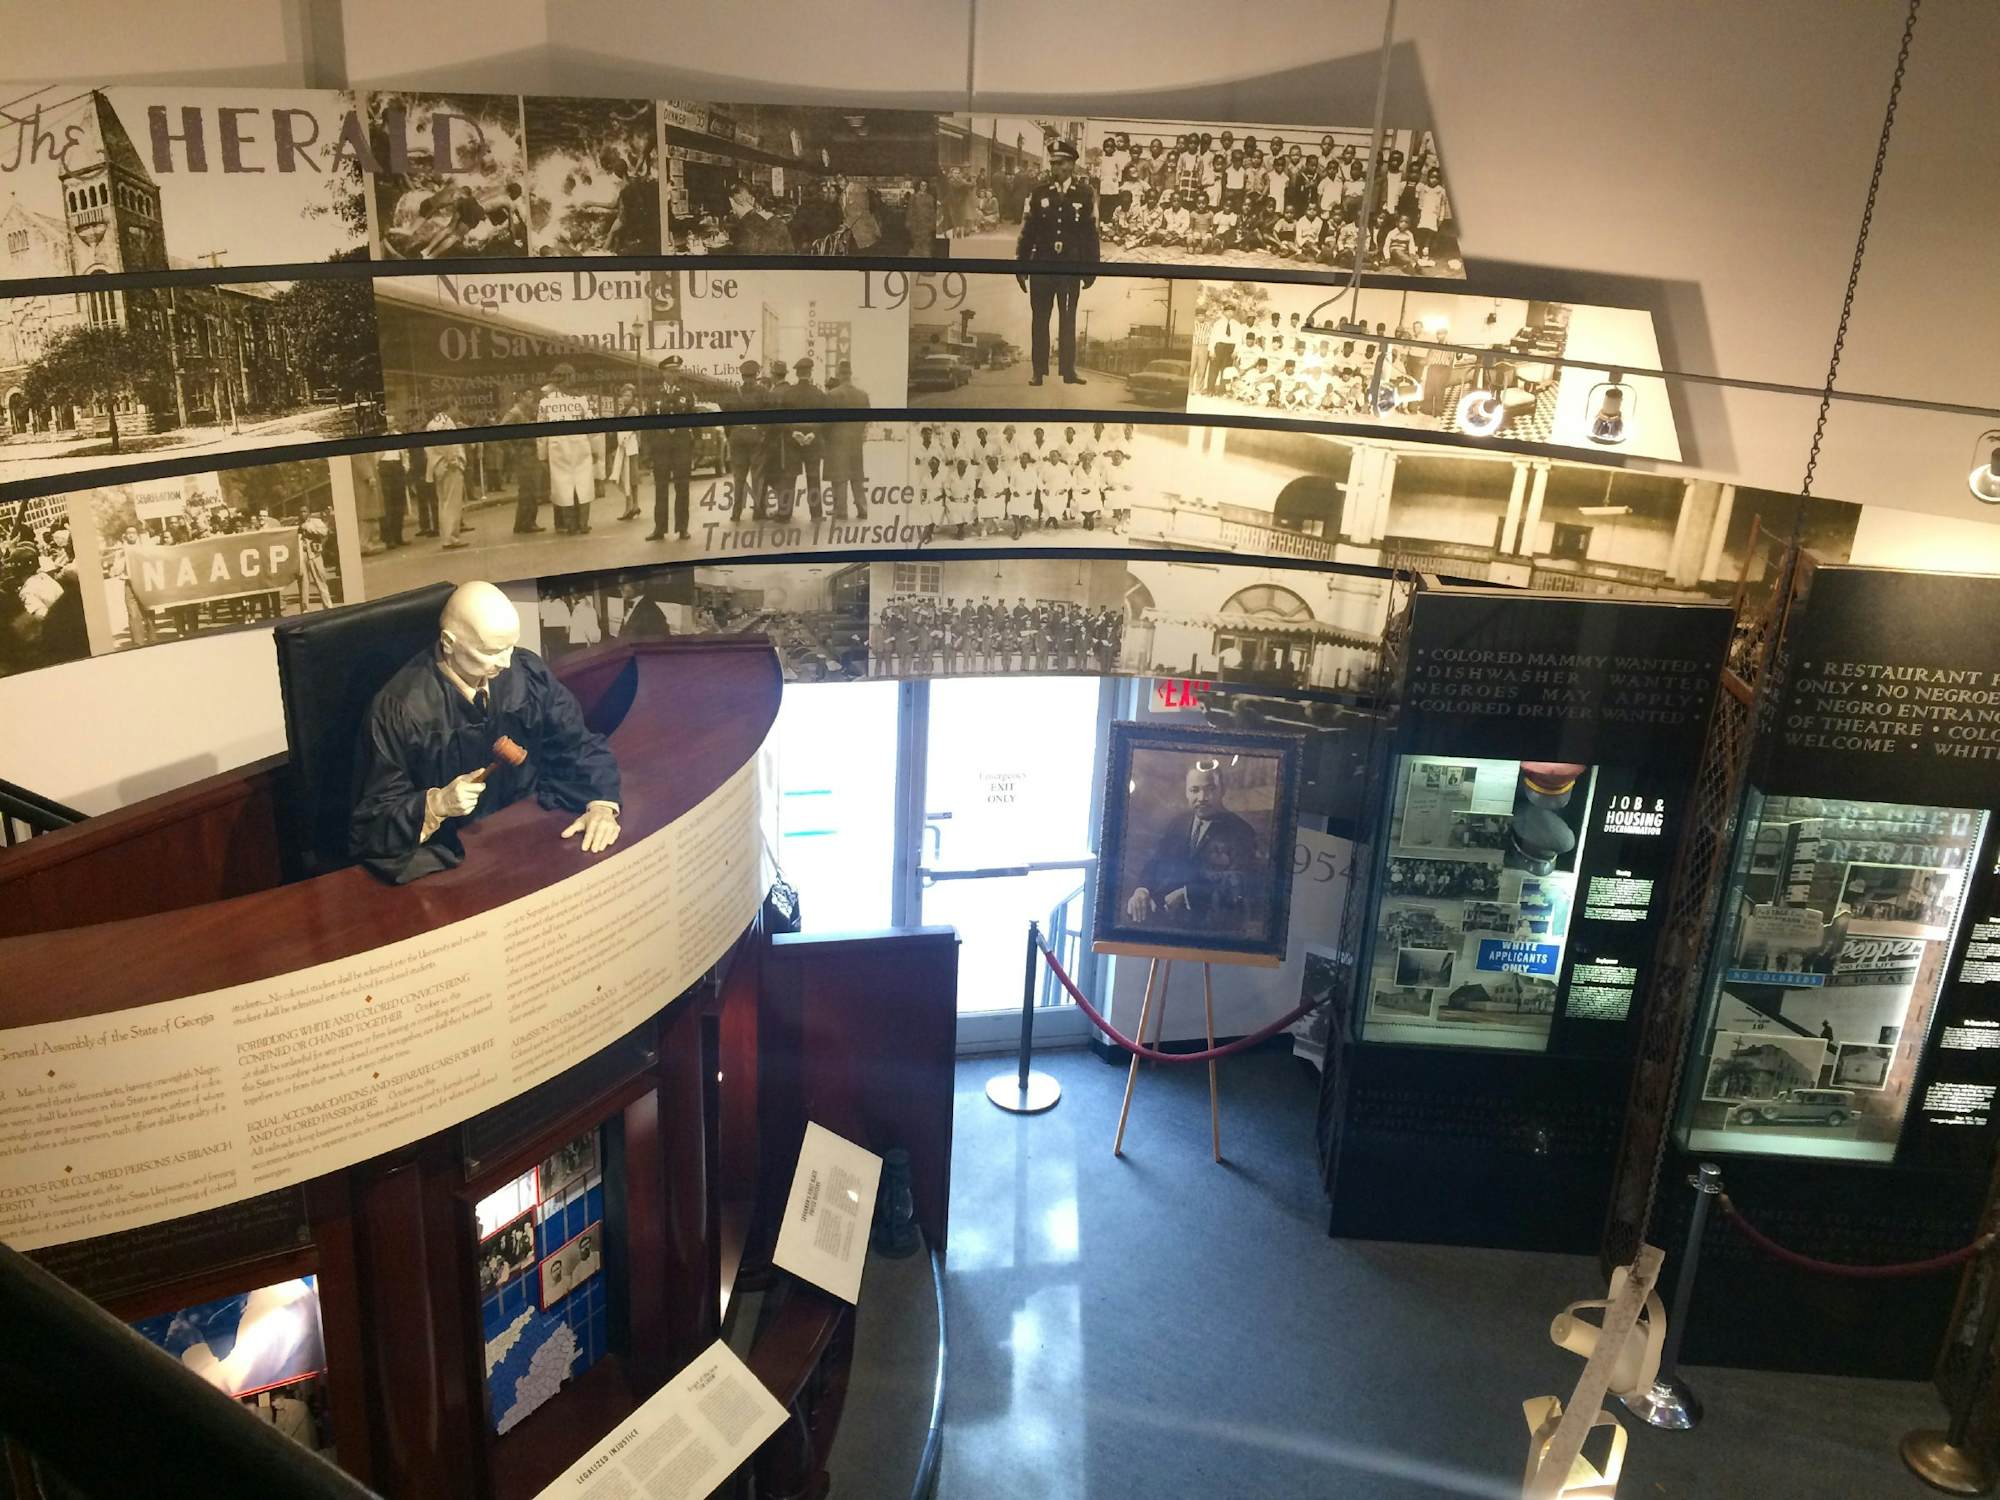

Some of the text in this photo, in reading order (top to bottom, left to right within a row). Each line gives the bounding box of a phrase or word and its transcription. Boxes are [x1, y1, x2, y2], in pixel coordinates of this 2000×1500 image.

[148, 105, 487, 176] HERALD
[437, 274, 562, 313] Negroes
[688, 270, 738, 299] Use
[858, 271, 968, 311] 1959
[439, 320, 756, 361] Of Savannah Library
[700, 481, 734, 512] 43
[743, 481, 836, 516] Negroe
[703, 515, 931, 551] Trial on Thursday
[143, 545, 290, 592] NAACP
[1431, 649, 1697, 673] COLORED MAMMY WANTED
[1427, 665, 1711, 690] DISHWASHER WANTED
[1823, 661, 1983, 686] RESTAURANT
[1411, 681, 1520, 699] NEGROES
[1542, 688, 1592, 702] MAY
[1796, 678, 1854, 695] ONLY
[1876, 683, 1910, 700] NO
[1419, 699, 1512, 716] COLORED
[1517, 704, 1592, 719] DRIVER
[1815, 699, 1893, 716] NEGRO
[1787, 714, 1820, 729] OF
[1823, 716, 1924, 737] THEATRE
[1785, 733, 1897, 753] WELCOME
[1609, 795, 1665, 812] JOB &
[1604, 824, 1662, 836] DISCRIMINATION
[1605, 811, 1664, 828] HOUSING
[1489, 951, 1548, 964] APPLICANTS
[1502, 941, 1538, 952] WHITE
[1501, 963, 1530, 973] ONLY
[1733, 971, 1750, 980] NO
[42, 1035, 93, 1054] Assembly
[97, 1031, 107, 1046] of
[112, 1028, 128, 1042] the
[131, 1025, 157, 1038] State
[162, 1018, 171, 1033] of
[174, 1014, 214, 1029] Georgia
[236, 1029, 298, 1053] FORBIDDING
[299, 1019, 329, 1035] WHITE
[333, 1012, 353, 1025] AND
[239, 1044, 291, 1065] CONFINED
[247, 1115, 276, 1132] EQUAL
[248, 1130, 272, 1144] AND
[0, 1182, 46, 1198] CHOOLS
[71, 1167, 122, 1185] COLORED
[124, 1156, 170, 1175] PERSONS
[172, 1152, 186, 1164] AS
[187, 1141, 232, 1159] BRANCH
[575, 1428, 640, 1485] LEGALIZED INJUSTICE
